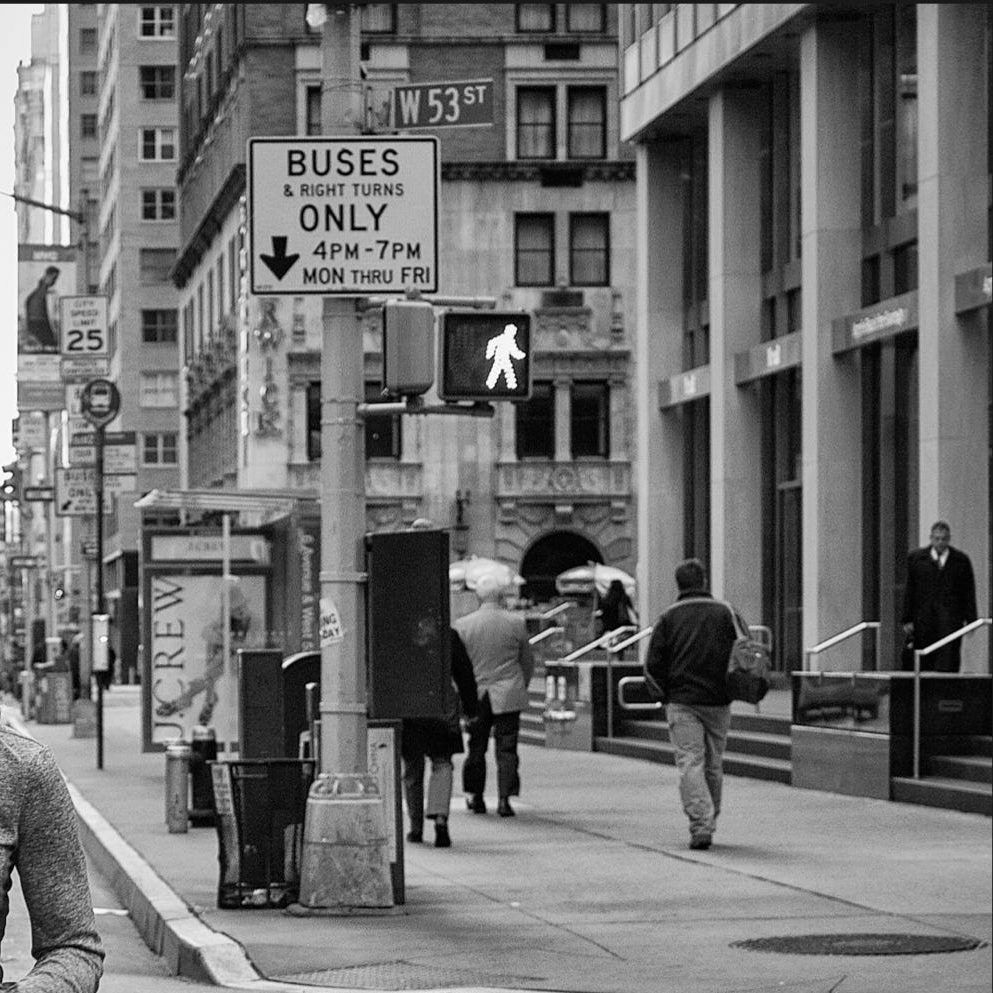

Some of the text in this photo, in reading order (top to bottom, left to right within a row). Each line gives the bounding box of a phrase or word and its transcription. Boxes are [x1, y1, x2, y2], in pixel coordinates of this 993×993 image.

[399, 85, 487, 125] W 53 ST
[287, 148, 399, 177] BUSES
[283, 183, 405, 197] & RIGHT TURNS
[299, 203, 388, 232] ONLY
[303, 266, 430, 285] MON THRU FRI
[70, 309, 99, 318] SPEED
[67, 328, 104, 351] 25
